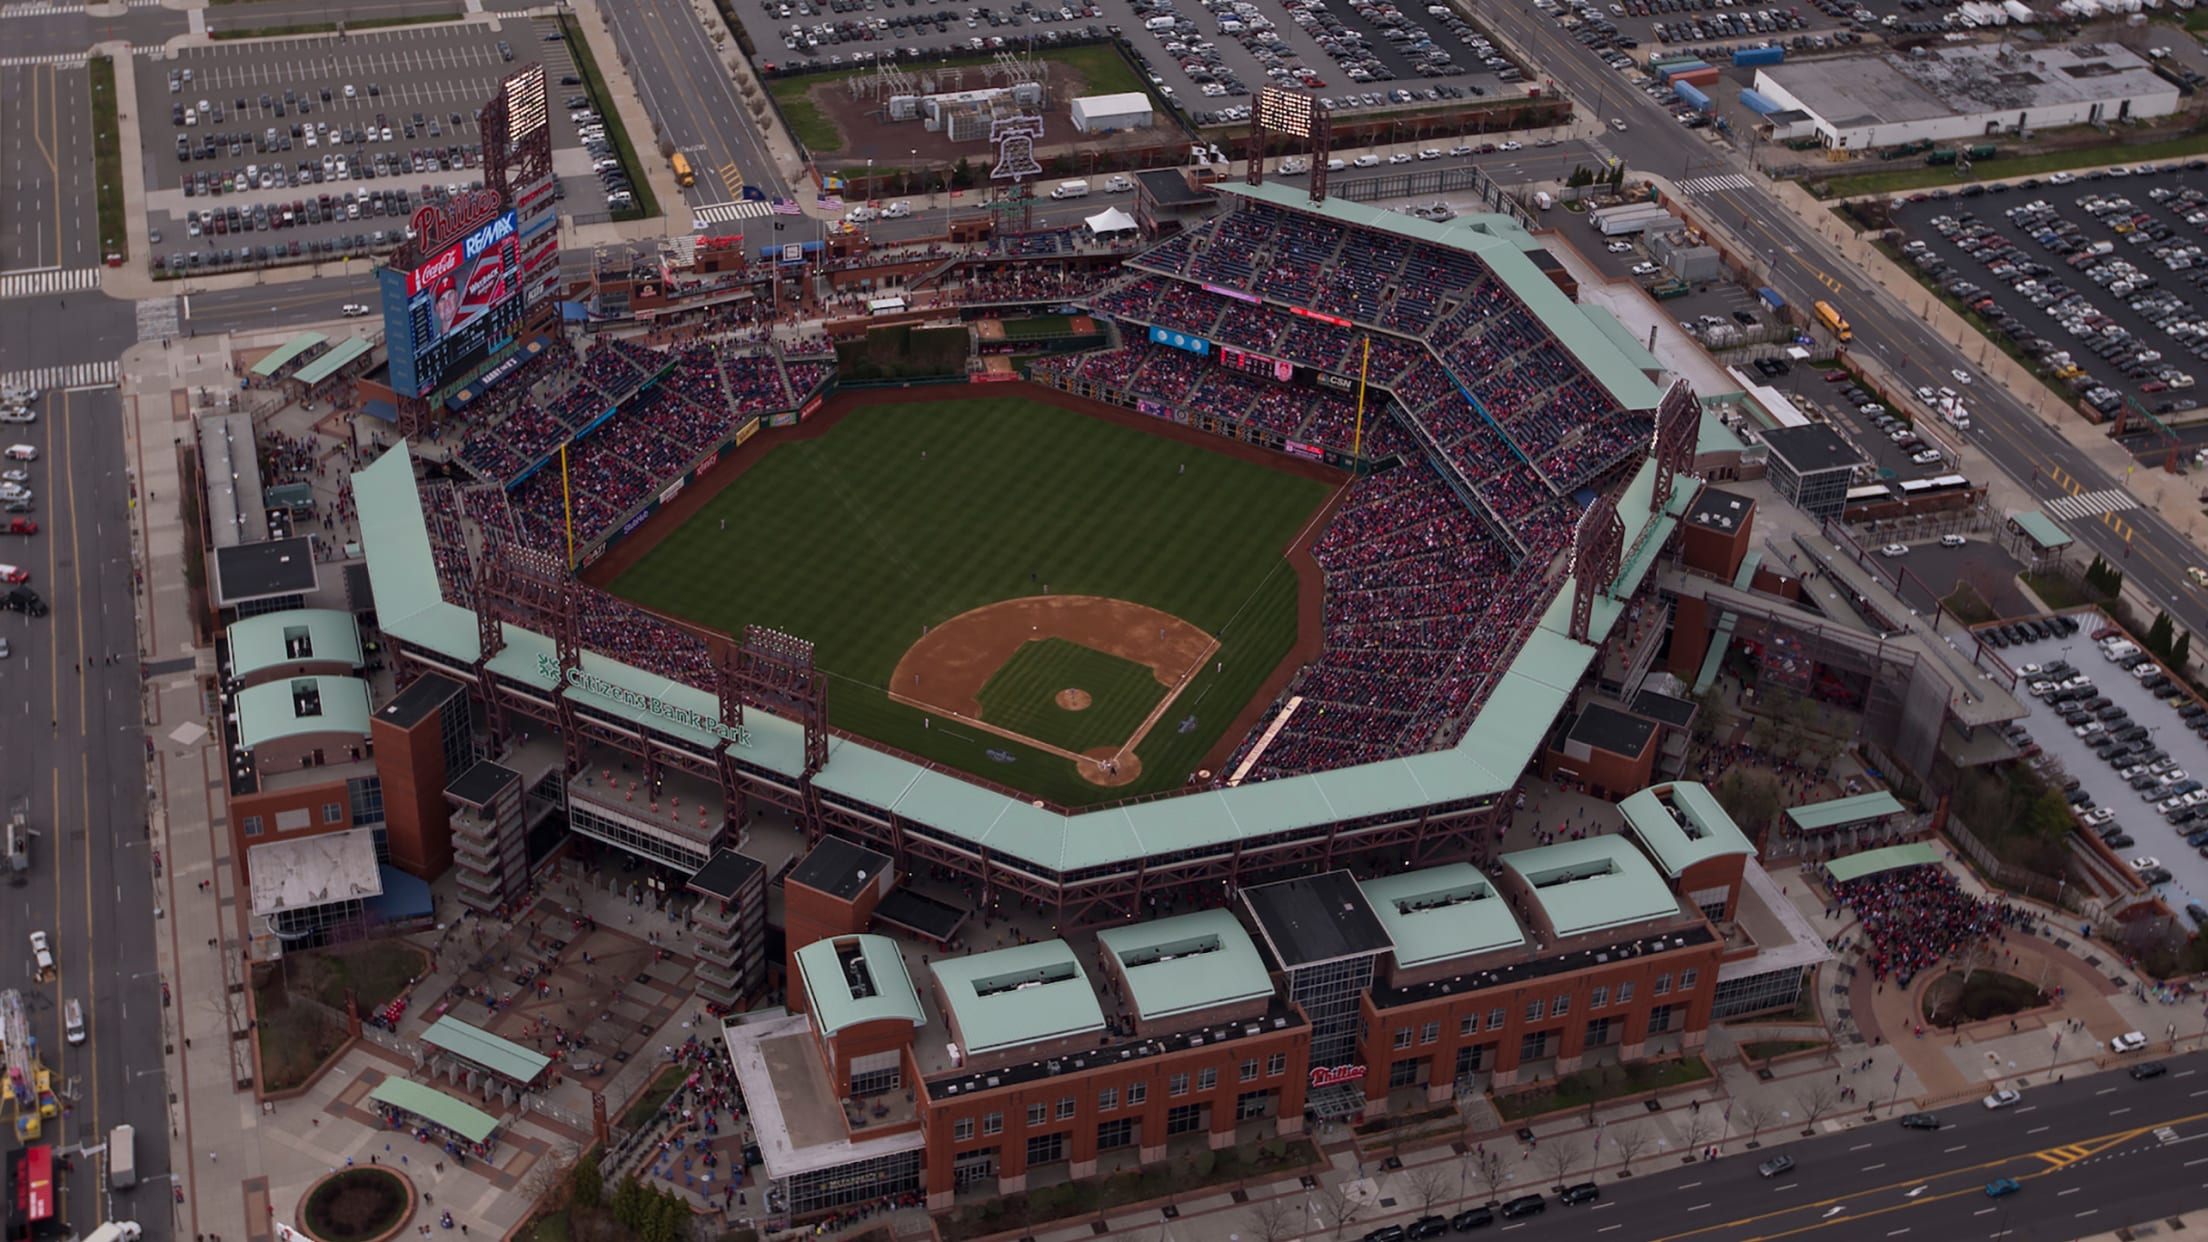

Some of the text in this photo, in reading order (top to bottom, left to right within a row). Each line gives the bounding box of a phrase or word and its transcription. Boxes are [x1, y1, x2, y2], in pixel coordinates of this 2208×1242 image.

[411, 189, 501, 257] Phillies
[466, 212, 514, 258] RE/MAX
[566, 667, 752, 747] Citizens Bank Park
[1309, 1064, 1367, 1088] Phillies
